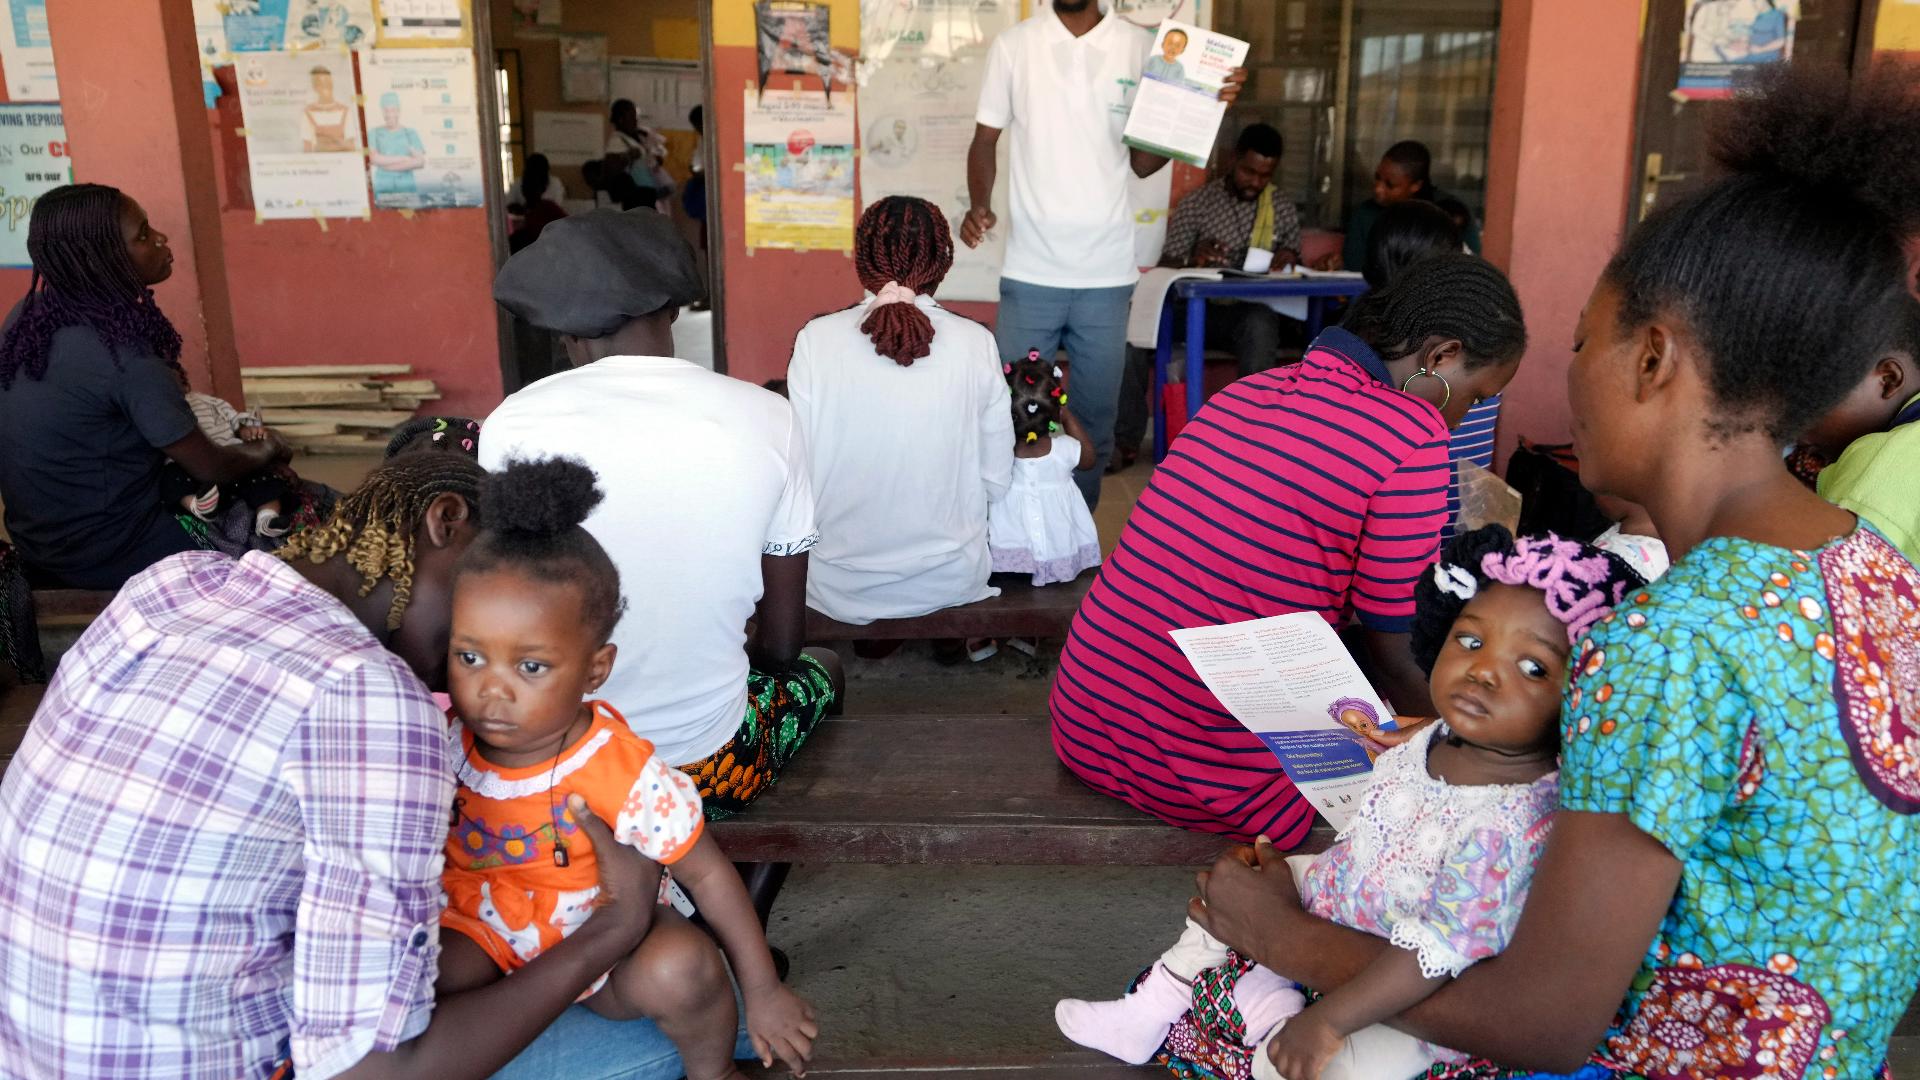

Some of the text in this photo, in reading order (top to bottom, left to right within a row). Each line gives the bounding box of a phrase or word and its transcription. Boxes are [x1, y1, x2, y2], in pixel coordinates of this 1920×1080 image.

[20, 143, 44, 156] Our
[25, 172, 61, 182] are our
